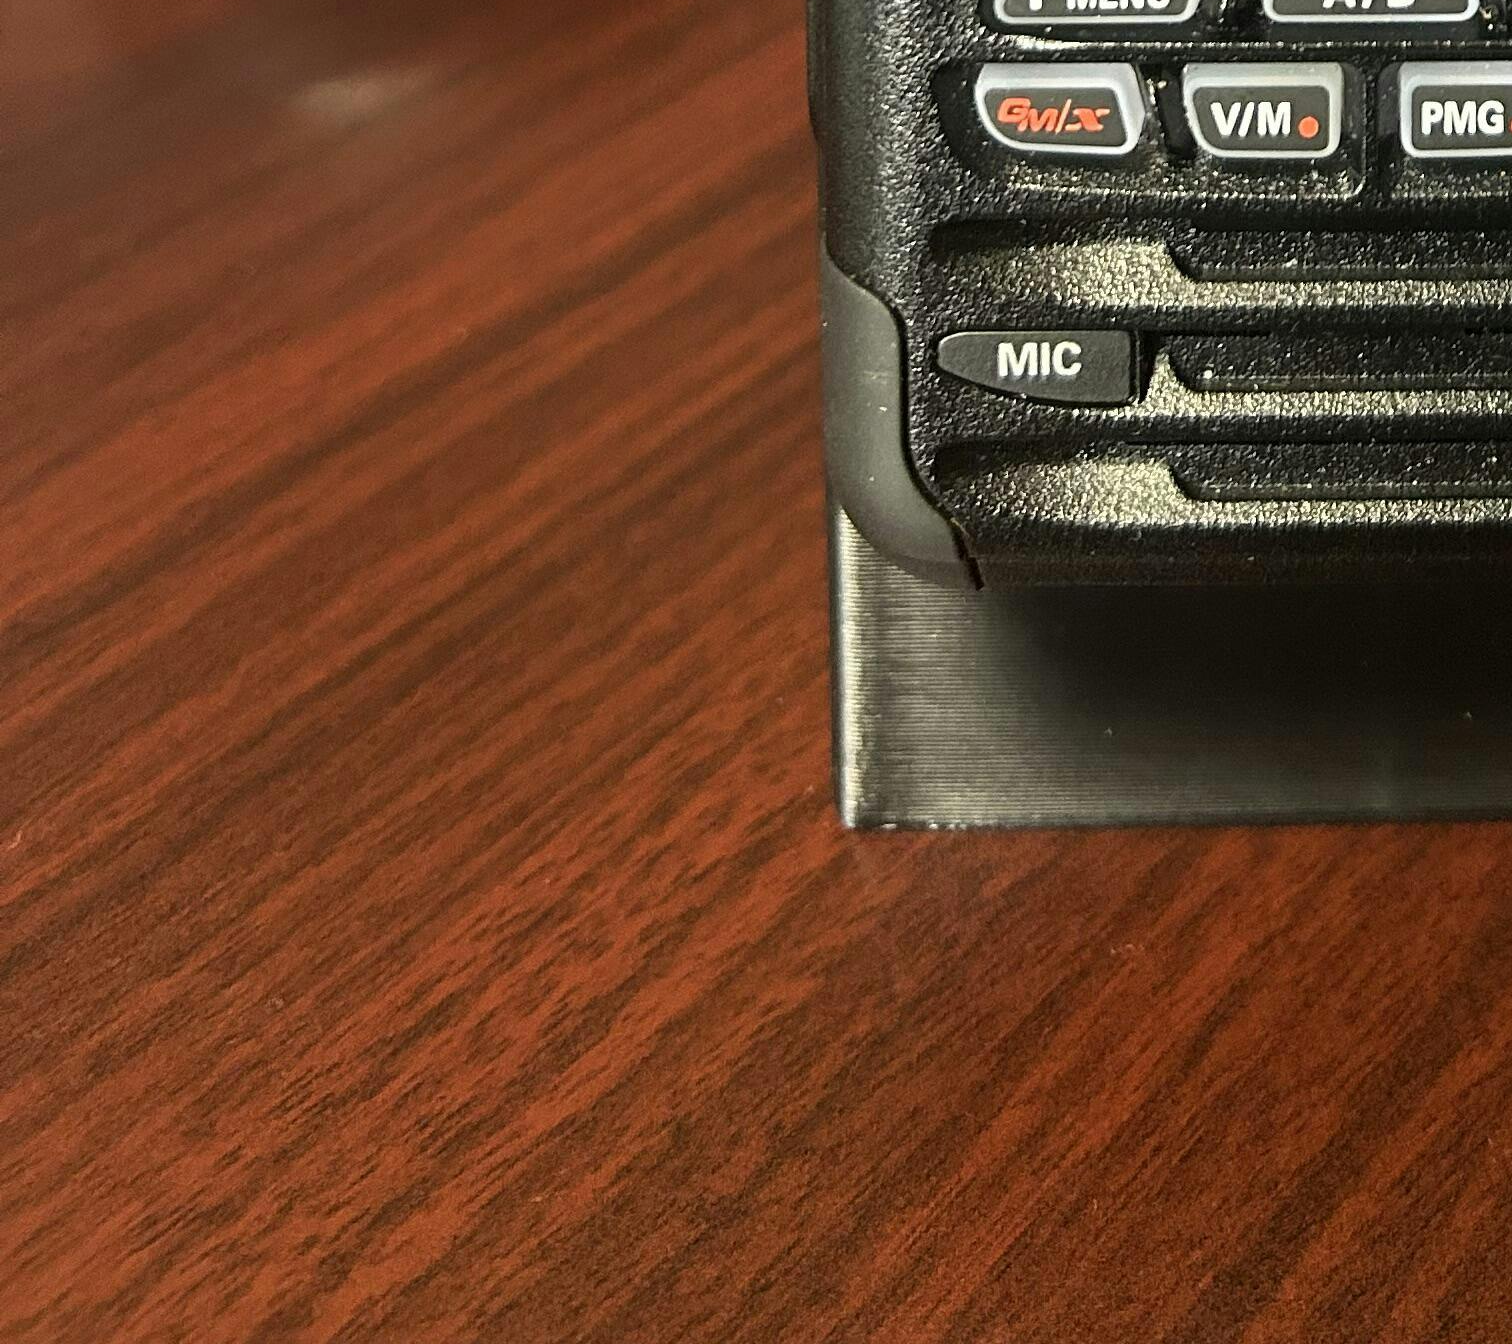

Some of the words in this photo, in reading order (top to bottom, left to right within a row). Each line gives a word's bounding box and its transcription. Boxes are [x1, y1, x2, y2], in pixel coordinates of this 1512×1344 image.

[1210, 101, 1293, 138] V/M
[1420, 104, 1506, 135] PMG
[996, 343, 1083, 377] MIC
